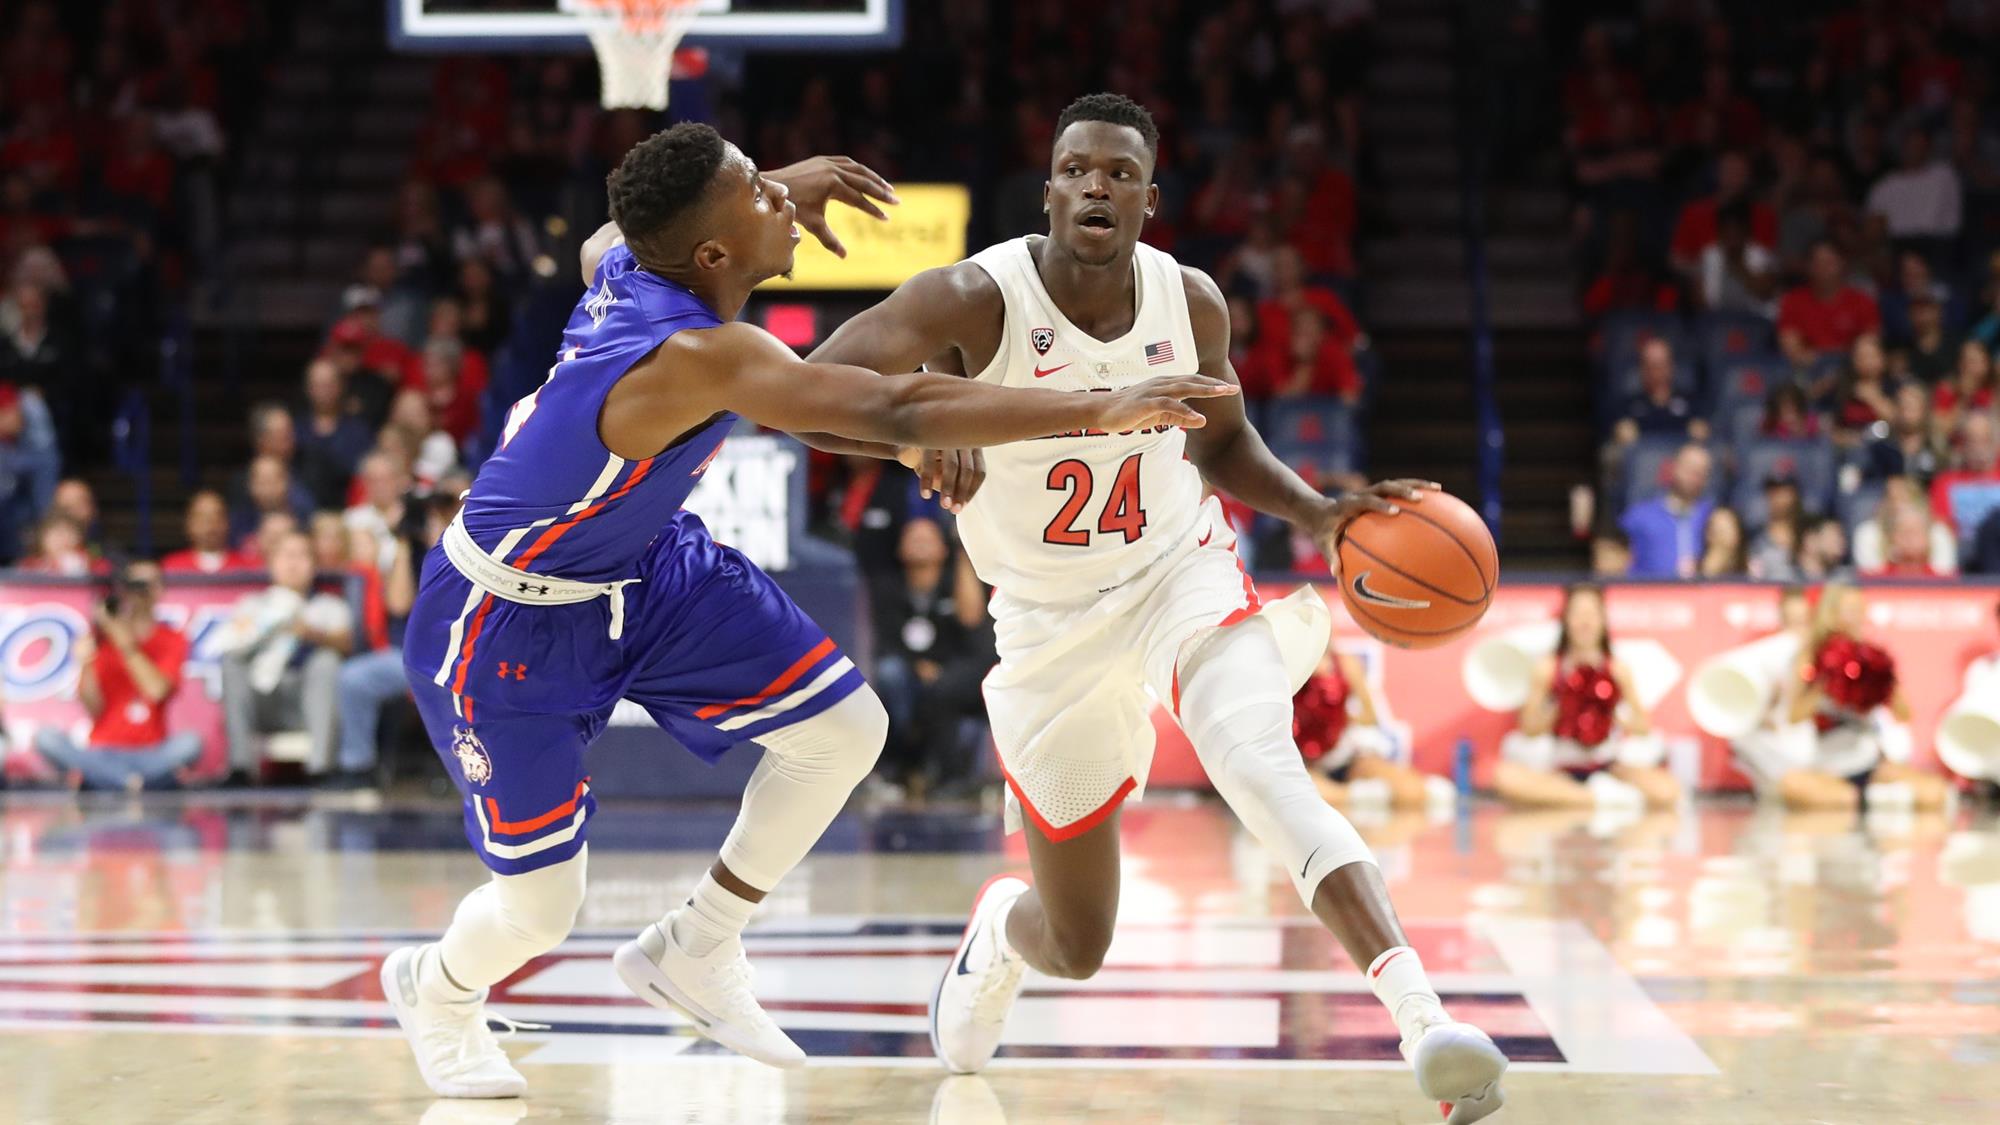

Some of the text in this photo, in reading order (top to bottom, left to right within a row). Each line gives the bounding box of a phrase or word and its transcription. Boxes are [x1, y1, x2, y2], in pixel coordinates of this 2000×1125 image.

[1033, 329, 1054, 345] PAC
[1036, 339, 1048, 351] 12
[1043, 452, 1147, 547] 24
